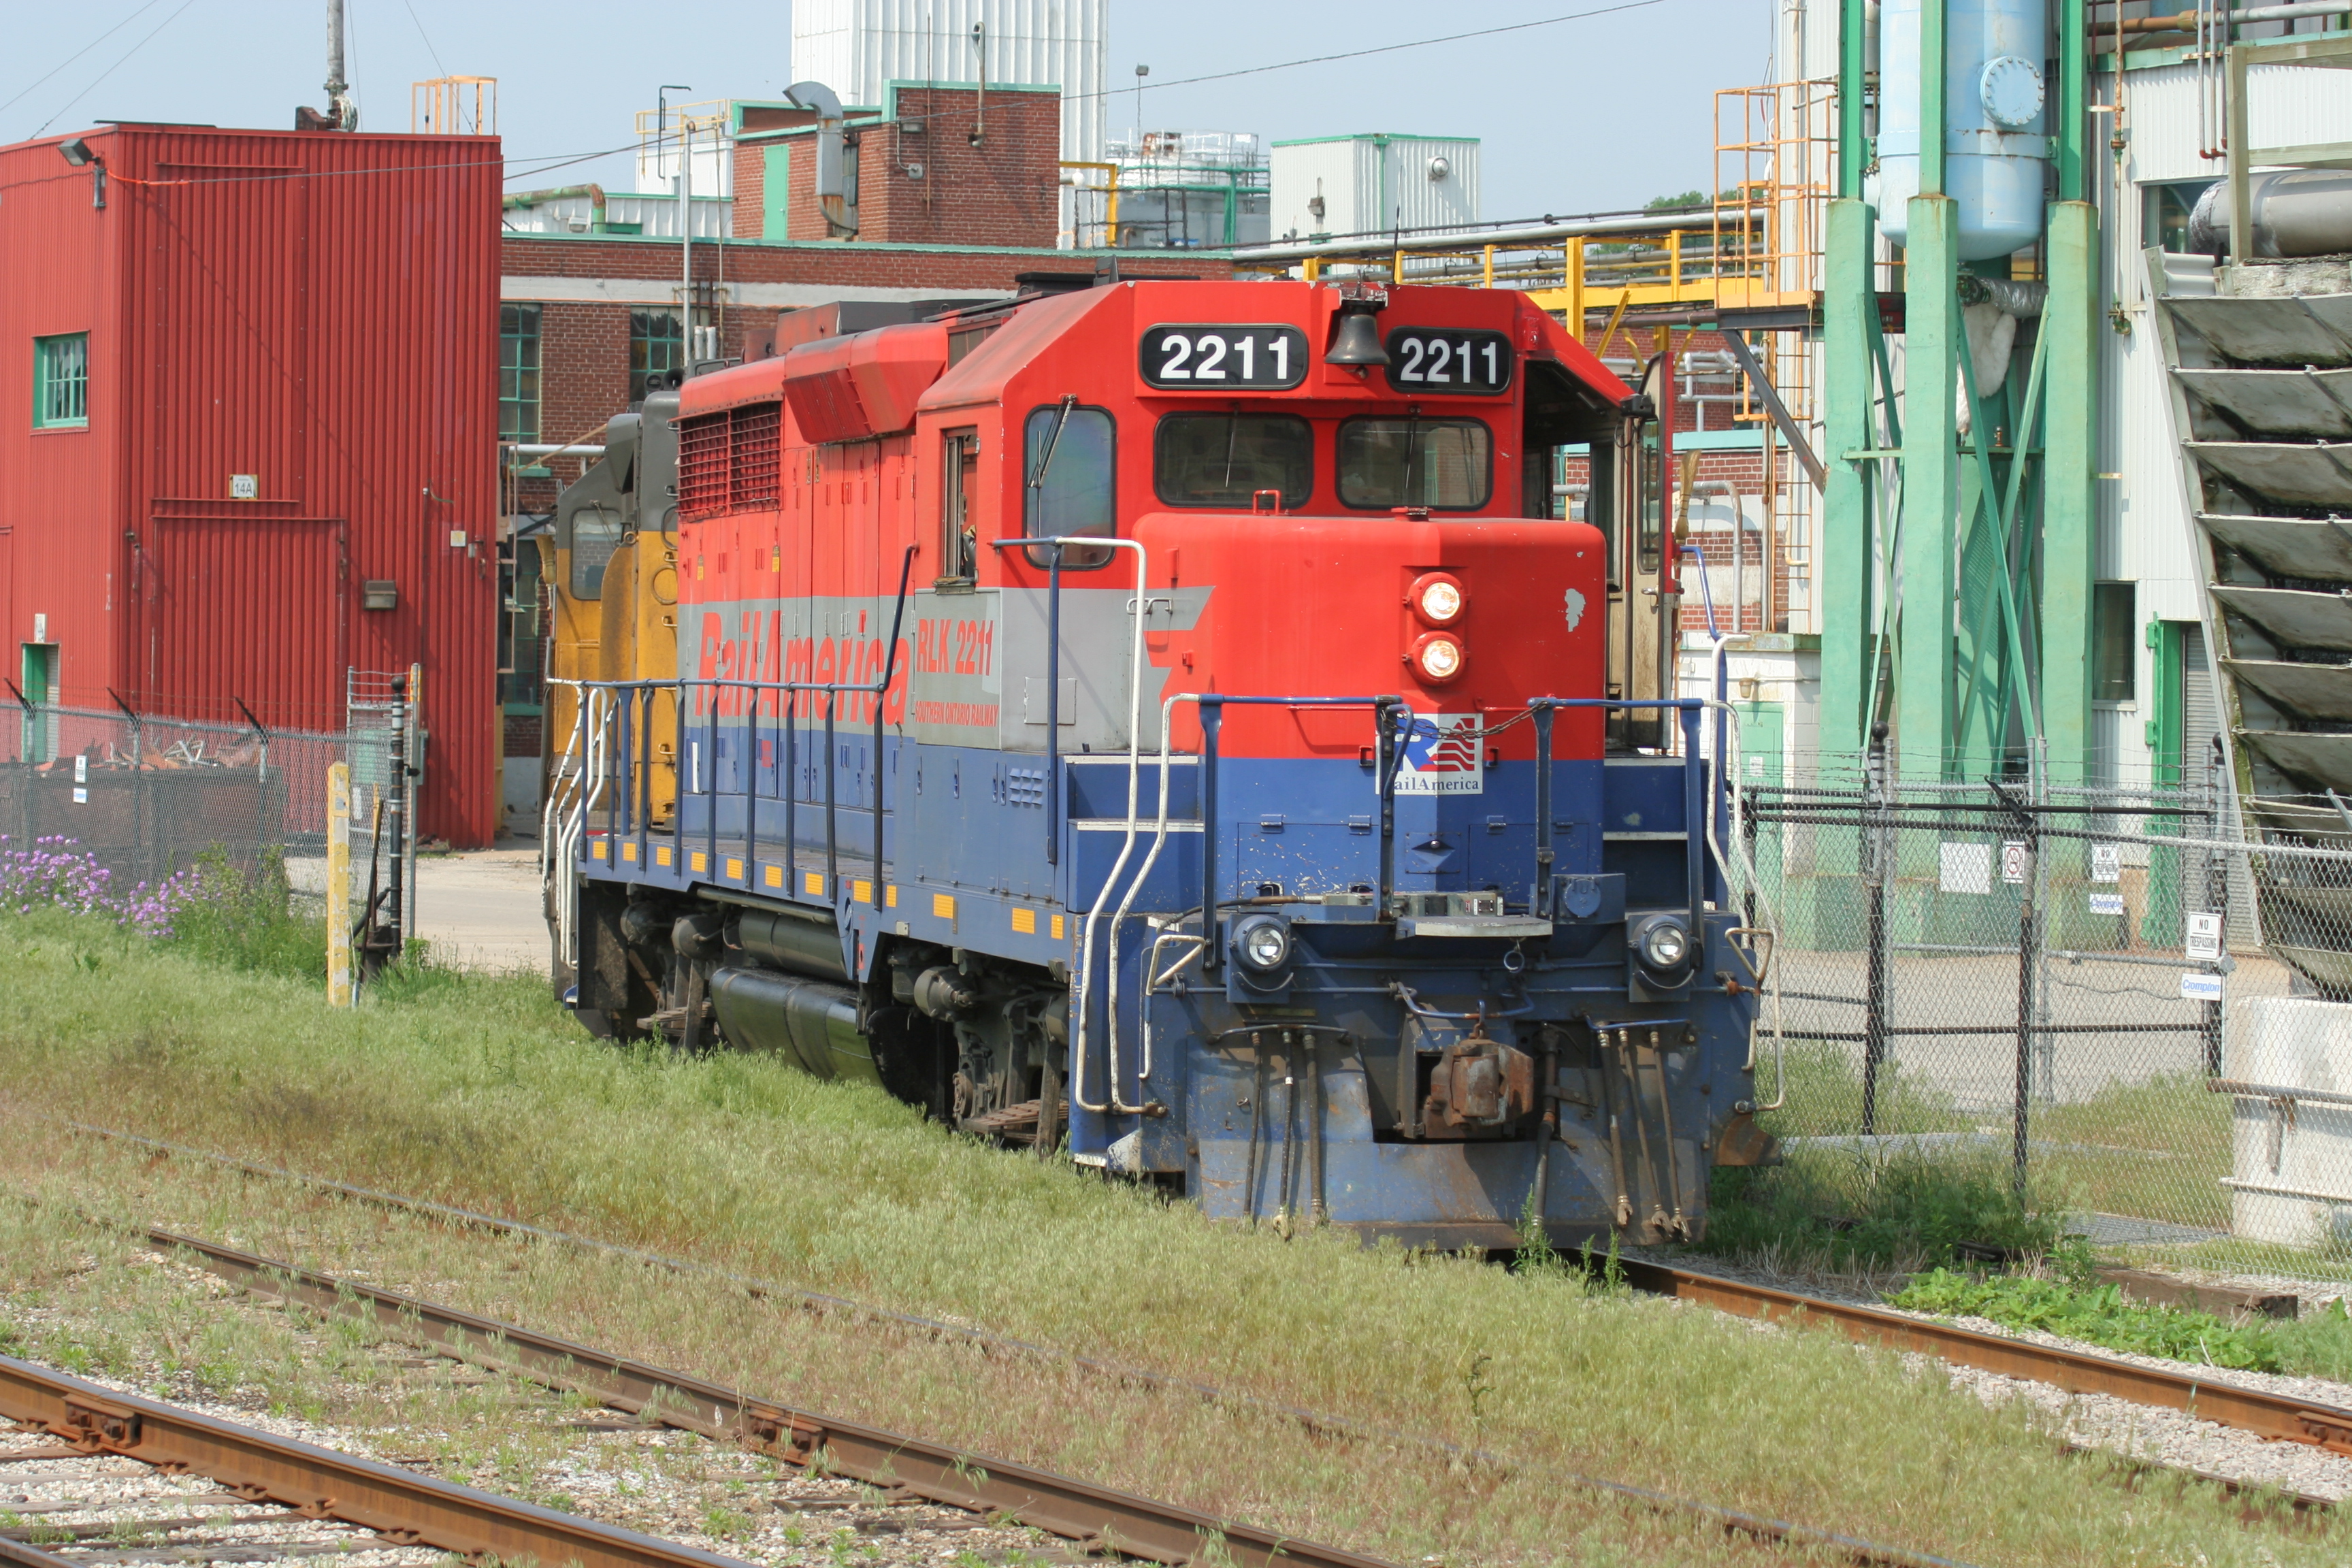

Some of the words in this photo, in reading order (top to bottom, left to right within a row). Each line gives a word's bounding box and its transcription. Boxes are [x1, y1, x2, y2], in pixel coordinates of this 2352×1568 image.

[1160, 334, 1288, 379] 2211
[1400, 338, 1496, 384] 2211
[234, 483, 252, 494] 14A
[917, 619, 952, 673] RLK
[955, 620, 994, 676] 2211
[695, 609, 910, 725] RailAmerica
[915, 700, 944, 724] SOUTHERN
[946, 702, 970, 726] ONTARIO
[971, 704, 998, 727] RAILWAY
[1394, 777, 1479, 790] ailAmerica
[2198, 919, 2209, 930] NO
[2183, 979, 2220, 993] Crompton
